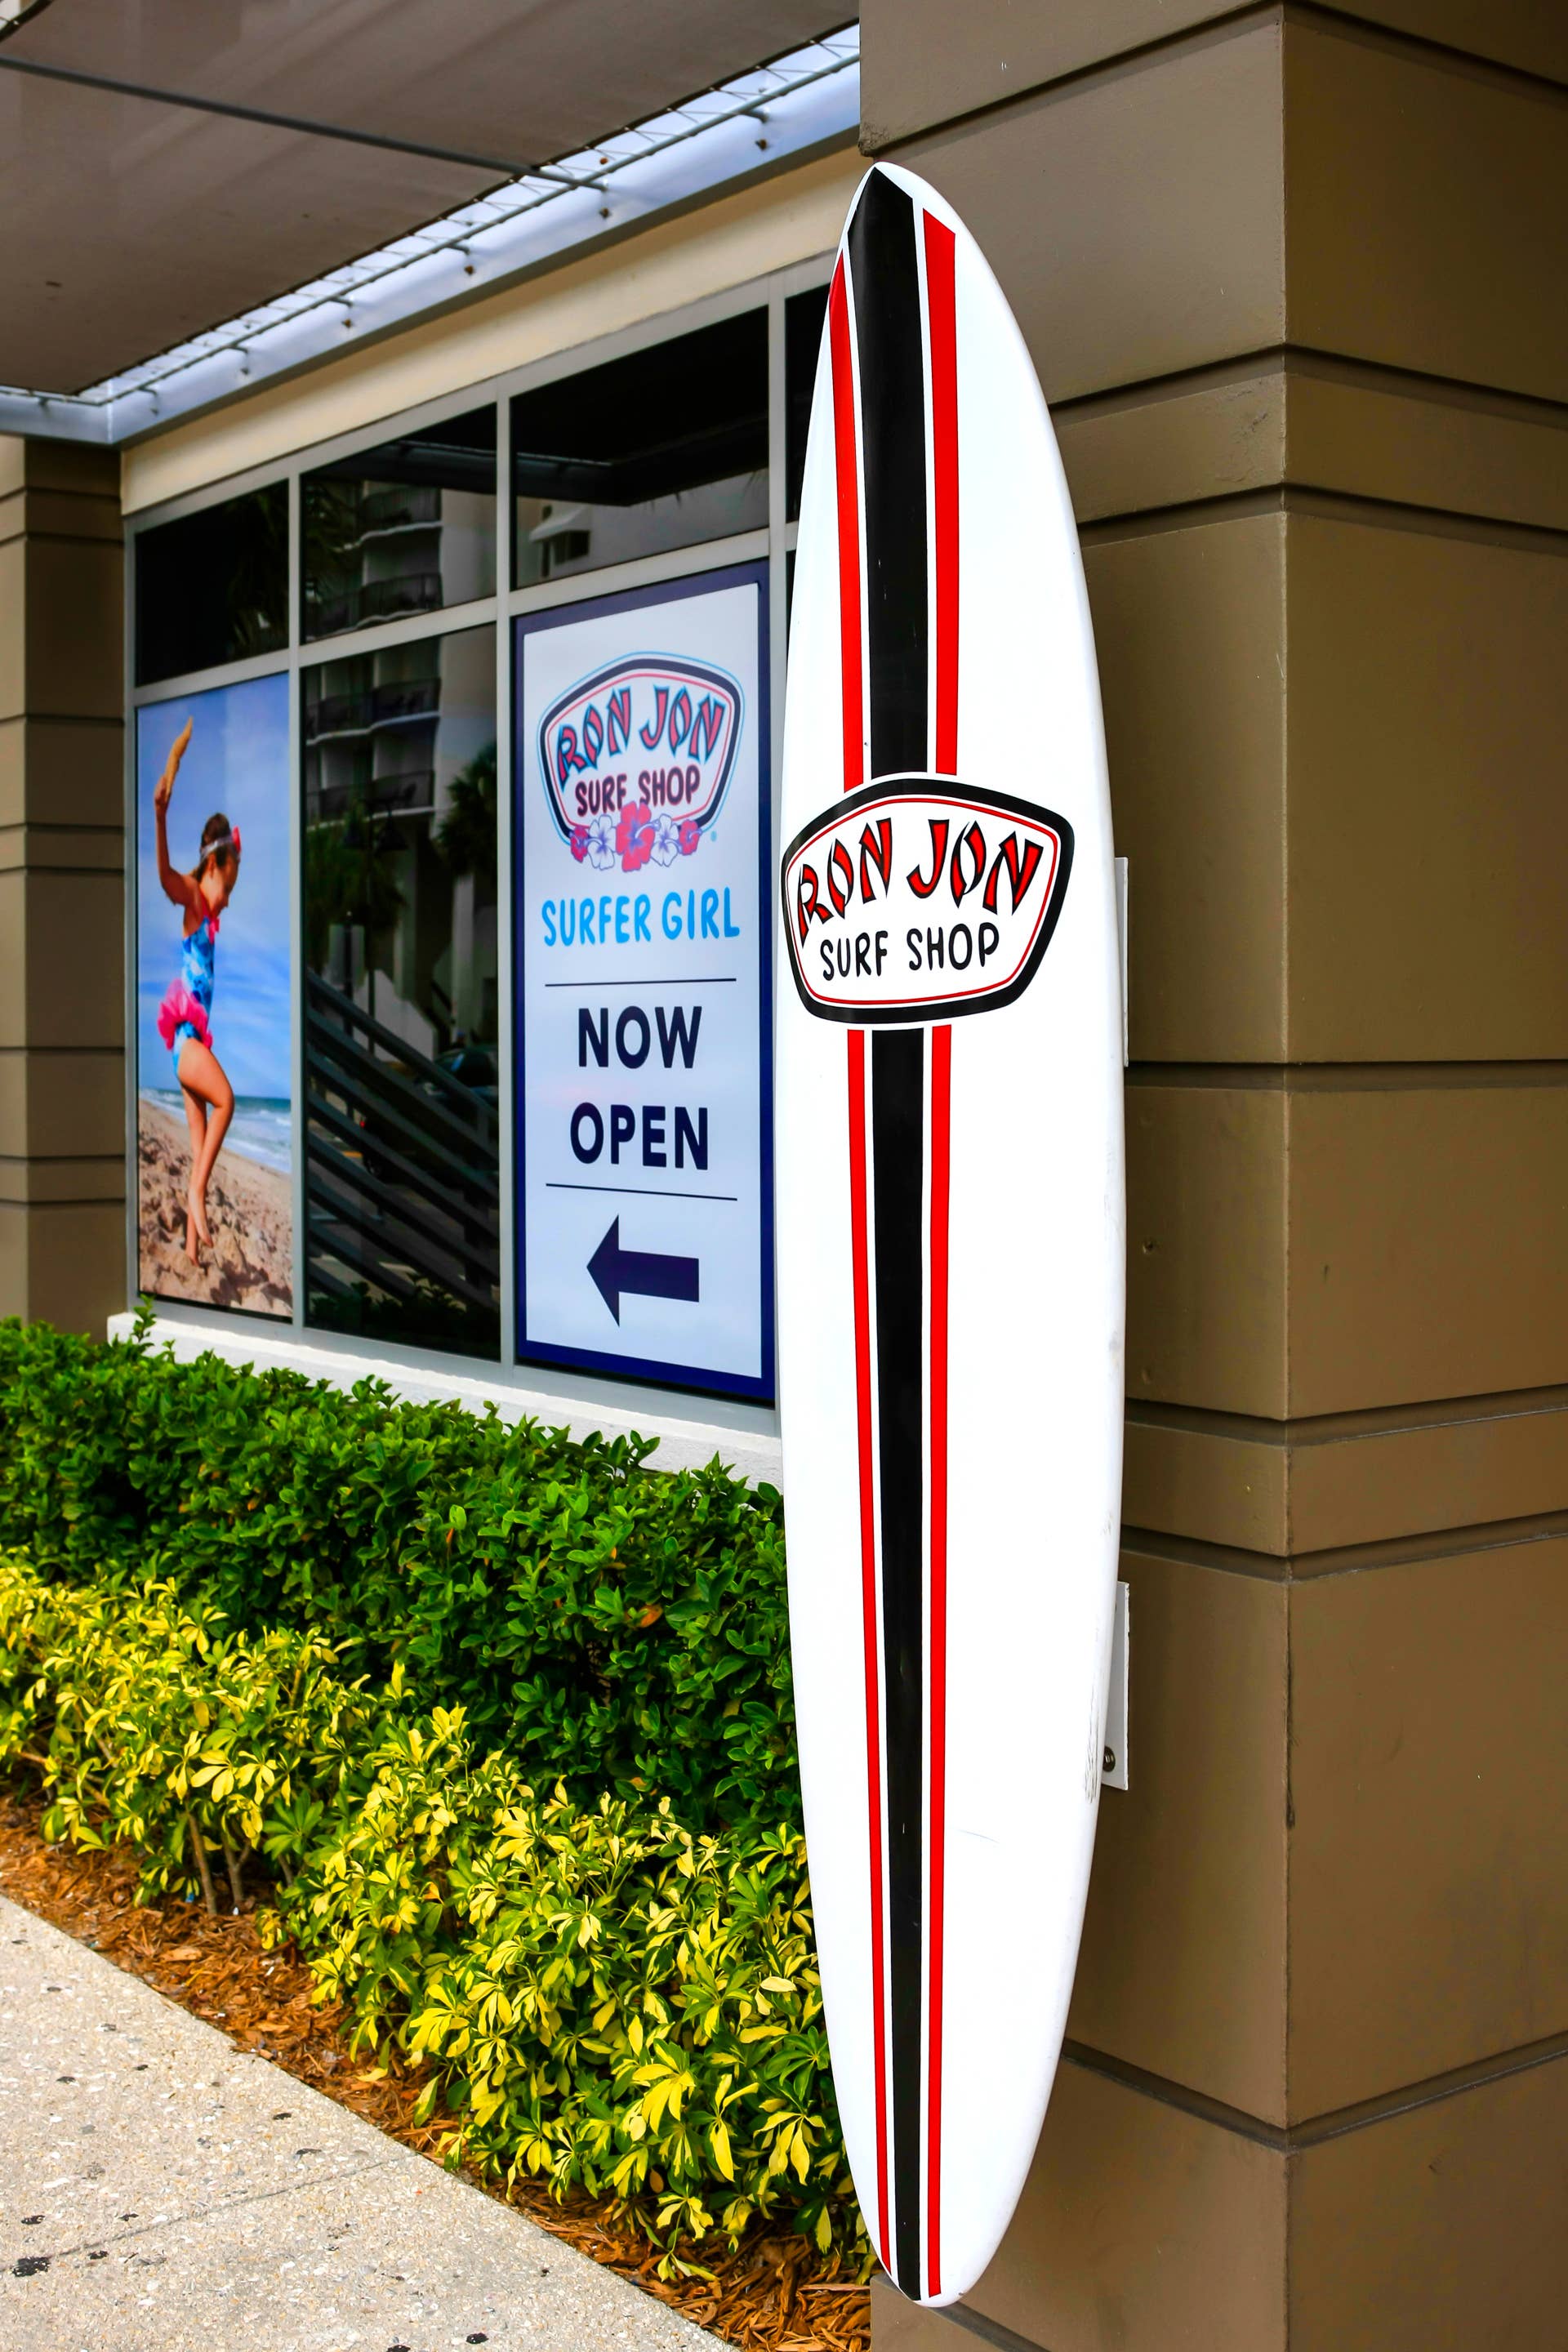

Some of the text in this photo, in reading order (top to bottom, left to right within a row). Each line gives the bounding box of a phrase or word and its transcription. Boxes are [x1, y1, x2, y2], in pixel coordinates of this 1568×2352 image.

[557, 686, 725, 791] RON JON
[575, 764, 701, 817] SURF SHOP
[798, 817, 1044, 948] RON JON
[541, 886, 741, 947] SURFER GIRL
[820, 922, 1000, 981] SURF SHOP
[578, 1005, 702, 1069] NOW
[571, 1102, 708, 1170] OPEN
